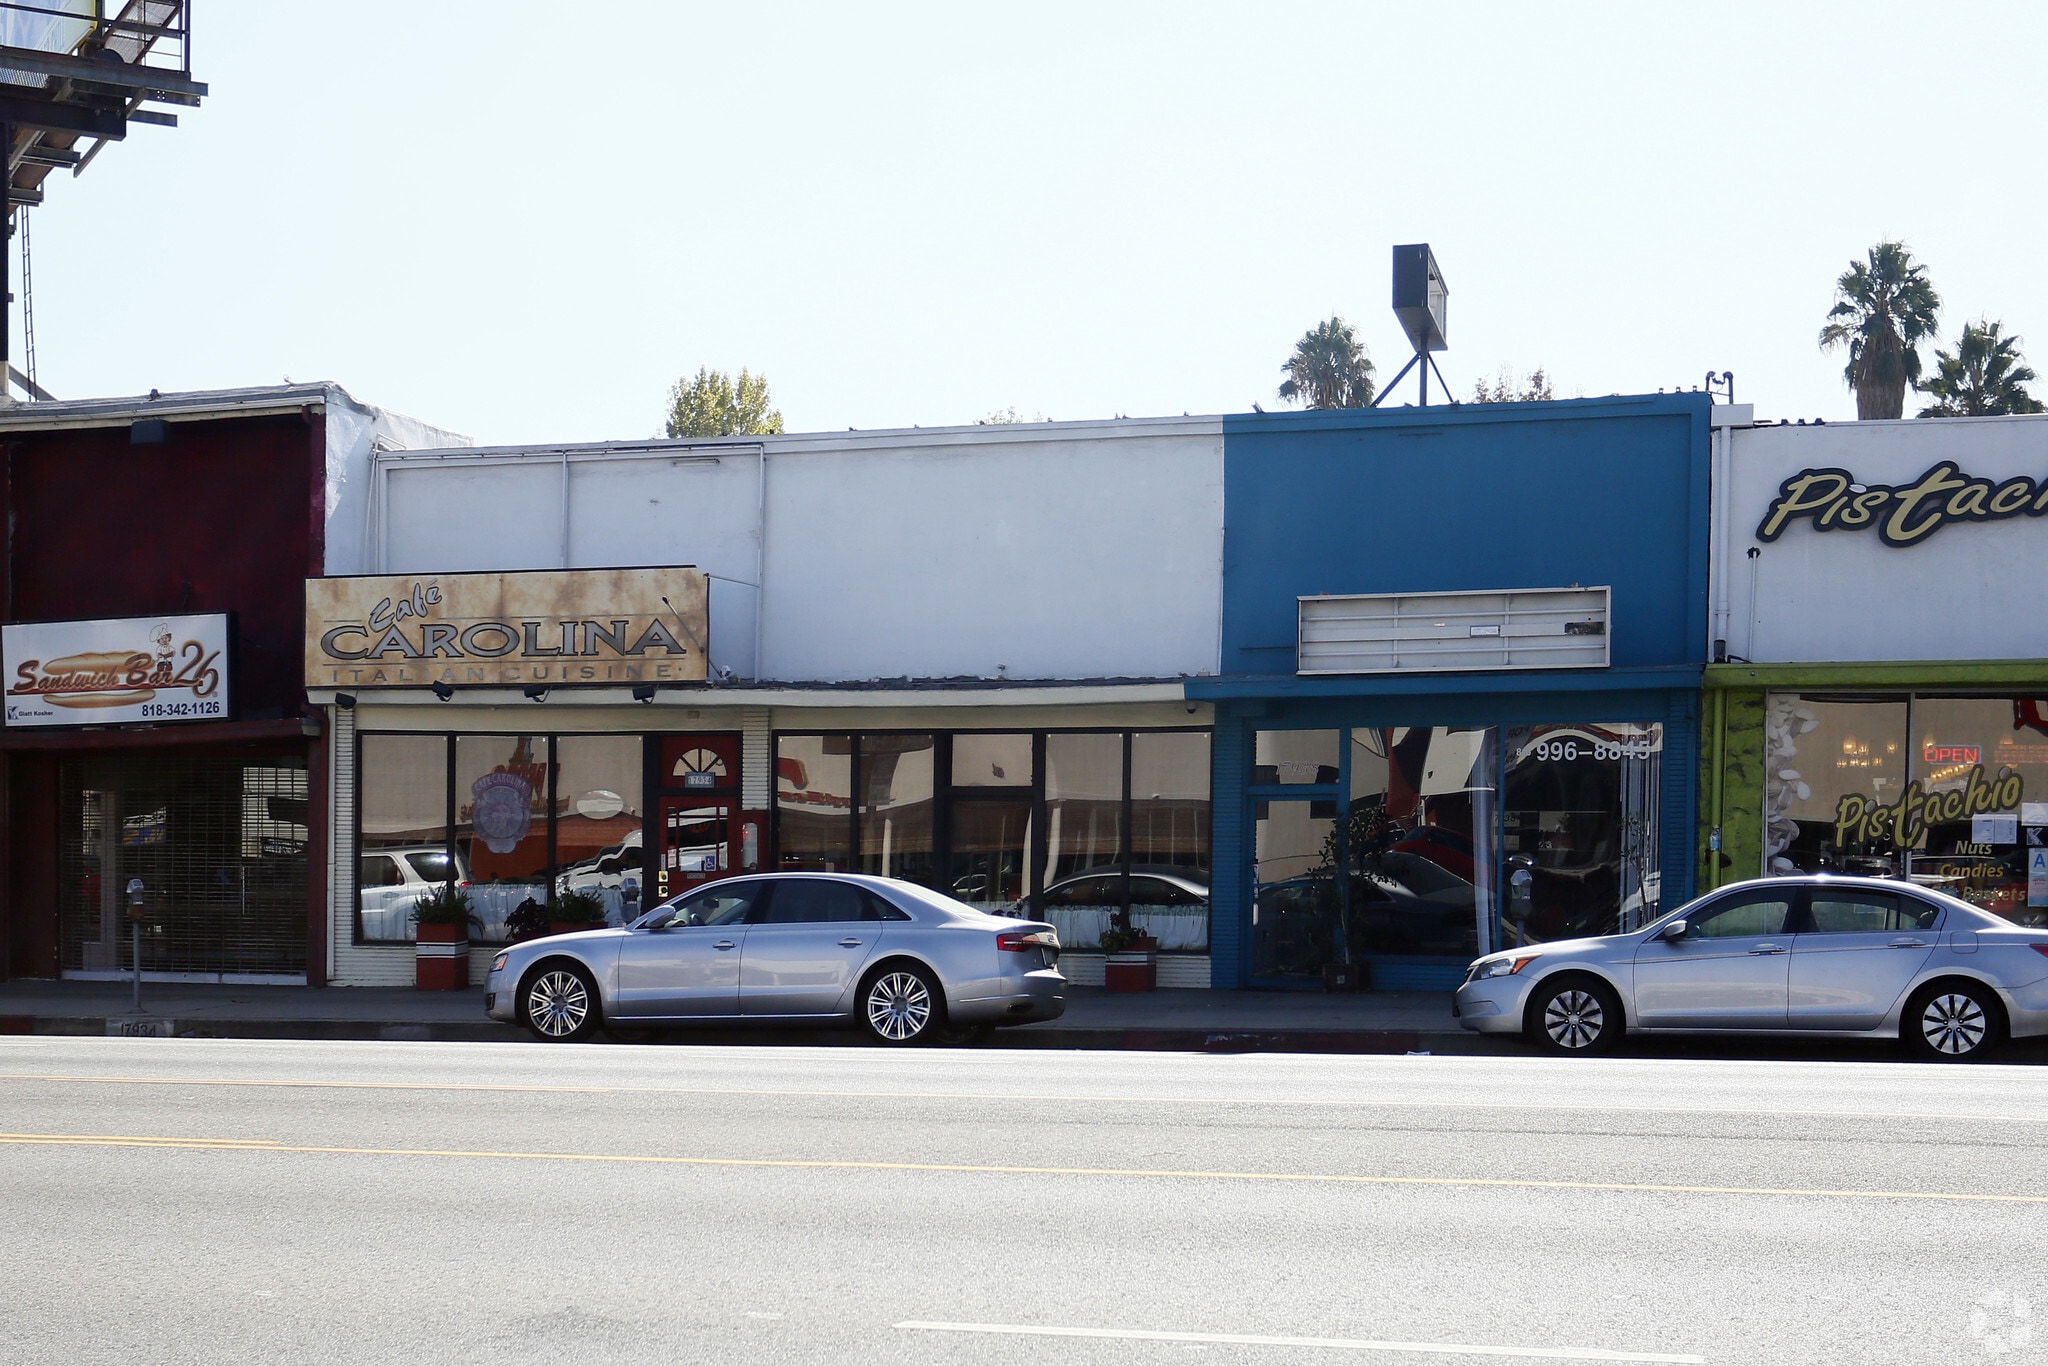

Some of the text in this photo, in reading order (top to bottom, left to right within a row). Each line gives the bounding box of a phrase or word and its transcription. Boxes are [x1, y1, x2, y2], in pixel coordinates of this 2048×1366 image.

[1756, 461, 2048, 547] Pistac
[367, 577, 443, 633] Café
[320, 618, 687, 660] CAROLINA
[14, 660, 119, 692] Sandwich
[124, 652, 173, 686] Bar
[332, 664, 672, 683] ITALIAN CUISINE
[141, 701, 220, 717] 818-342-1126
[1924, 748, 1979, 762] OPEN
[1834, 764, 2024, 850] Pistachio
[1955, 840, 1992, 855] Nuts
[2034, 853, 2046, 868] A
[1940, 863, 2004, 878] Candies
[1962, 886, 2026, 901] Baskets
